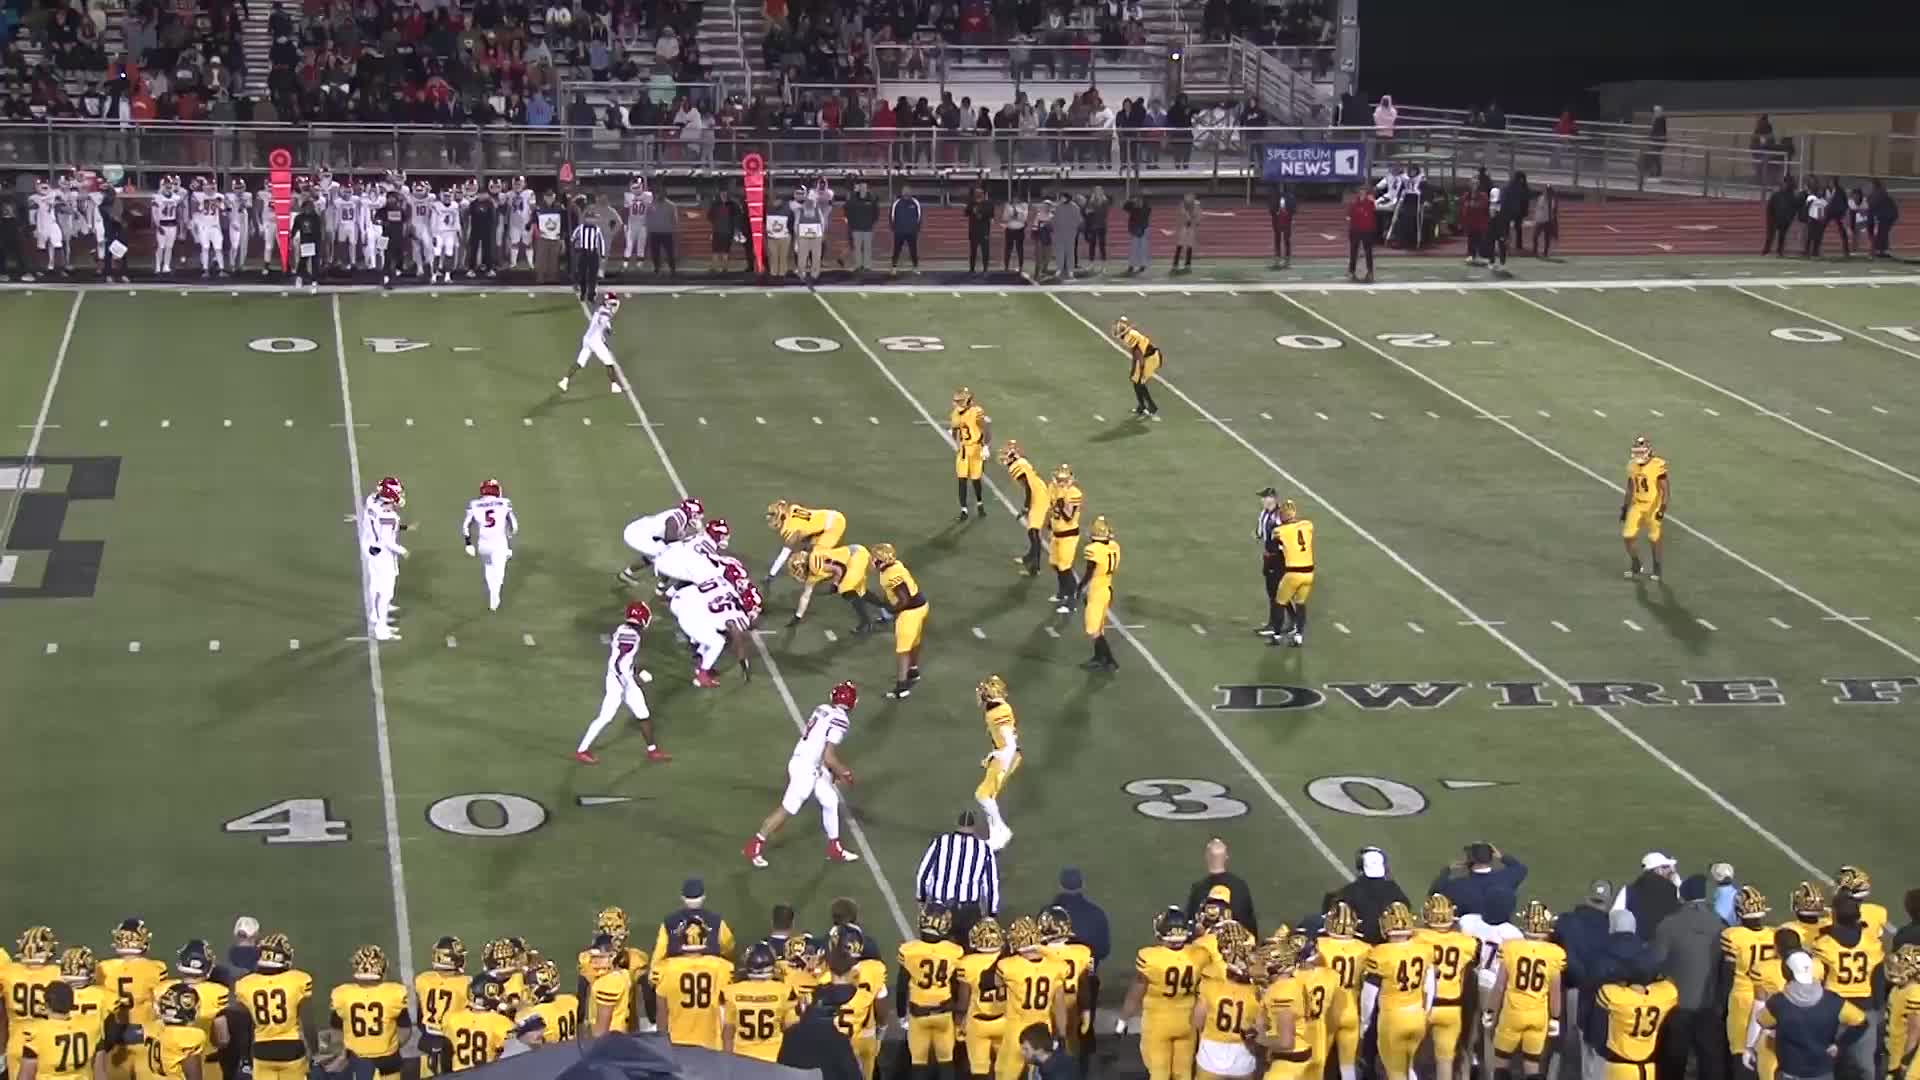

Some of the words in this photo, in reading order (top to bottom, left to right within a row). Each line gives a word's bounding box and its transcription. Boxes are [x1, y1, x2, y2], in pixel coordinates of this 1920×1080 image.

[1266, 149, 1331, 161] SPECTRUM
[1281, 161, 1331, 176] NEWS
[484, 509, 496, 528] 5
[1297, 529, 1306, 552] 4
[1211, 678, 1787, 710] DWIRE
[918, 959, 948, 990] 34
[1163, 965, 1194, 998] 94
[1396, 956, 1424, 992] 43
[1515, 956, 1547, 992] 86
[1837, 950, 1868, 985] 53
[118, 976, 134, 1010] 5
[253, 988, 288, 1025] 83
[426, 988, 453, 1025] 47
[679, 972, 713, 1009] 98
[1021, 976, 1051, 1010] 18
[350, 1001, 384, 1038] 63
[738, 1008, 775, 1041] 56
[1216, 998, 1245, 1034] 61
[1626, 1006, 1661, 1038] 13
[54, 1031, 89, 1073] 70
[456, 1027, 489, 1066] 28
